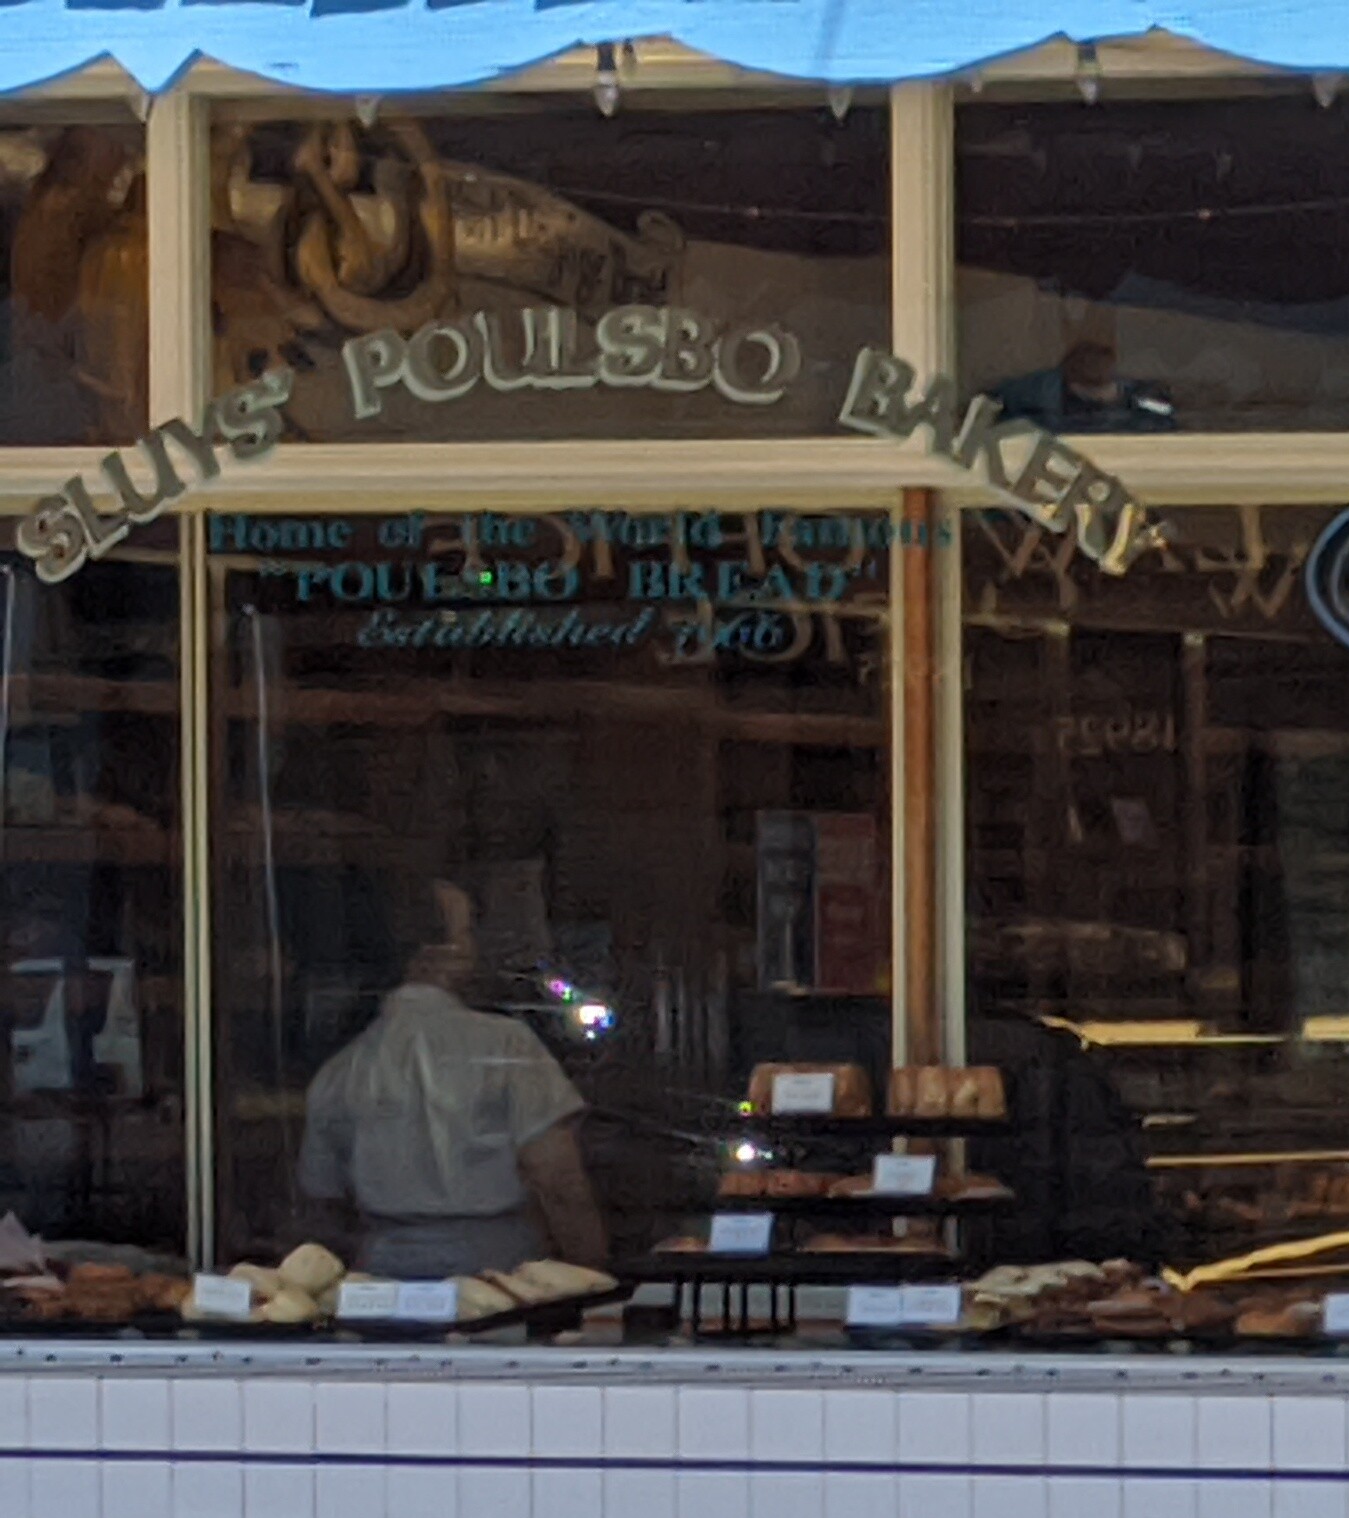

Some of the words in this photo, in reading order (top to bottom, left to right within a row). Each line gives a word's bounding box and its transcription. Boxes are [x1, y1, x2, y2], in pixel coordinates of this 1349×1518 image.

[342, 303, 800, 420] POULSBO
[838, 345, 1168, 576] BAKERY
[208, 512, 354, 553] Home
[378, 510, 426, 549] of
